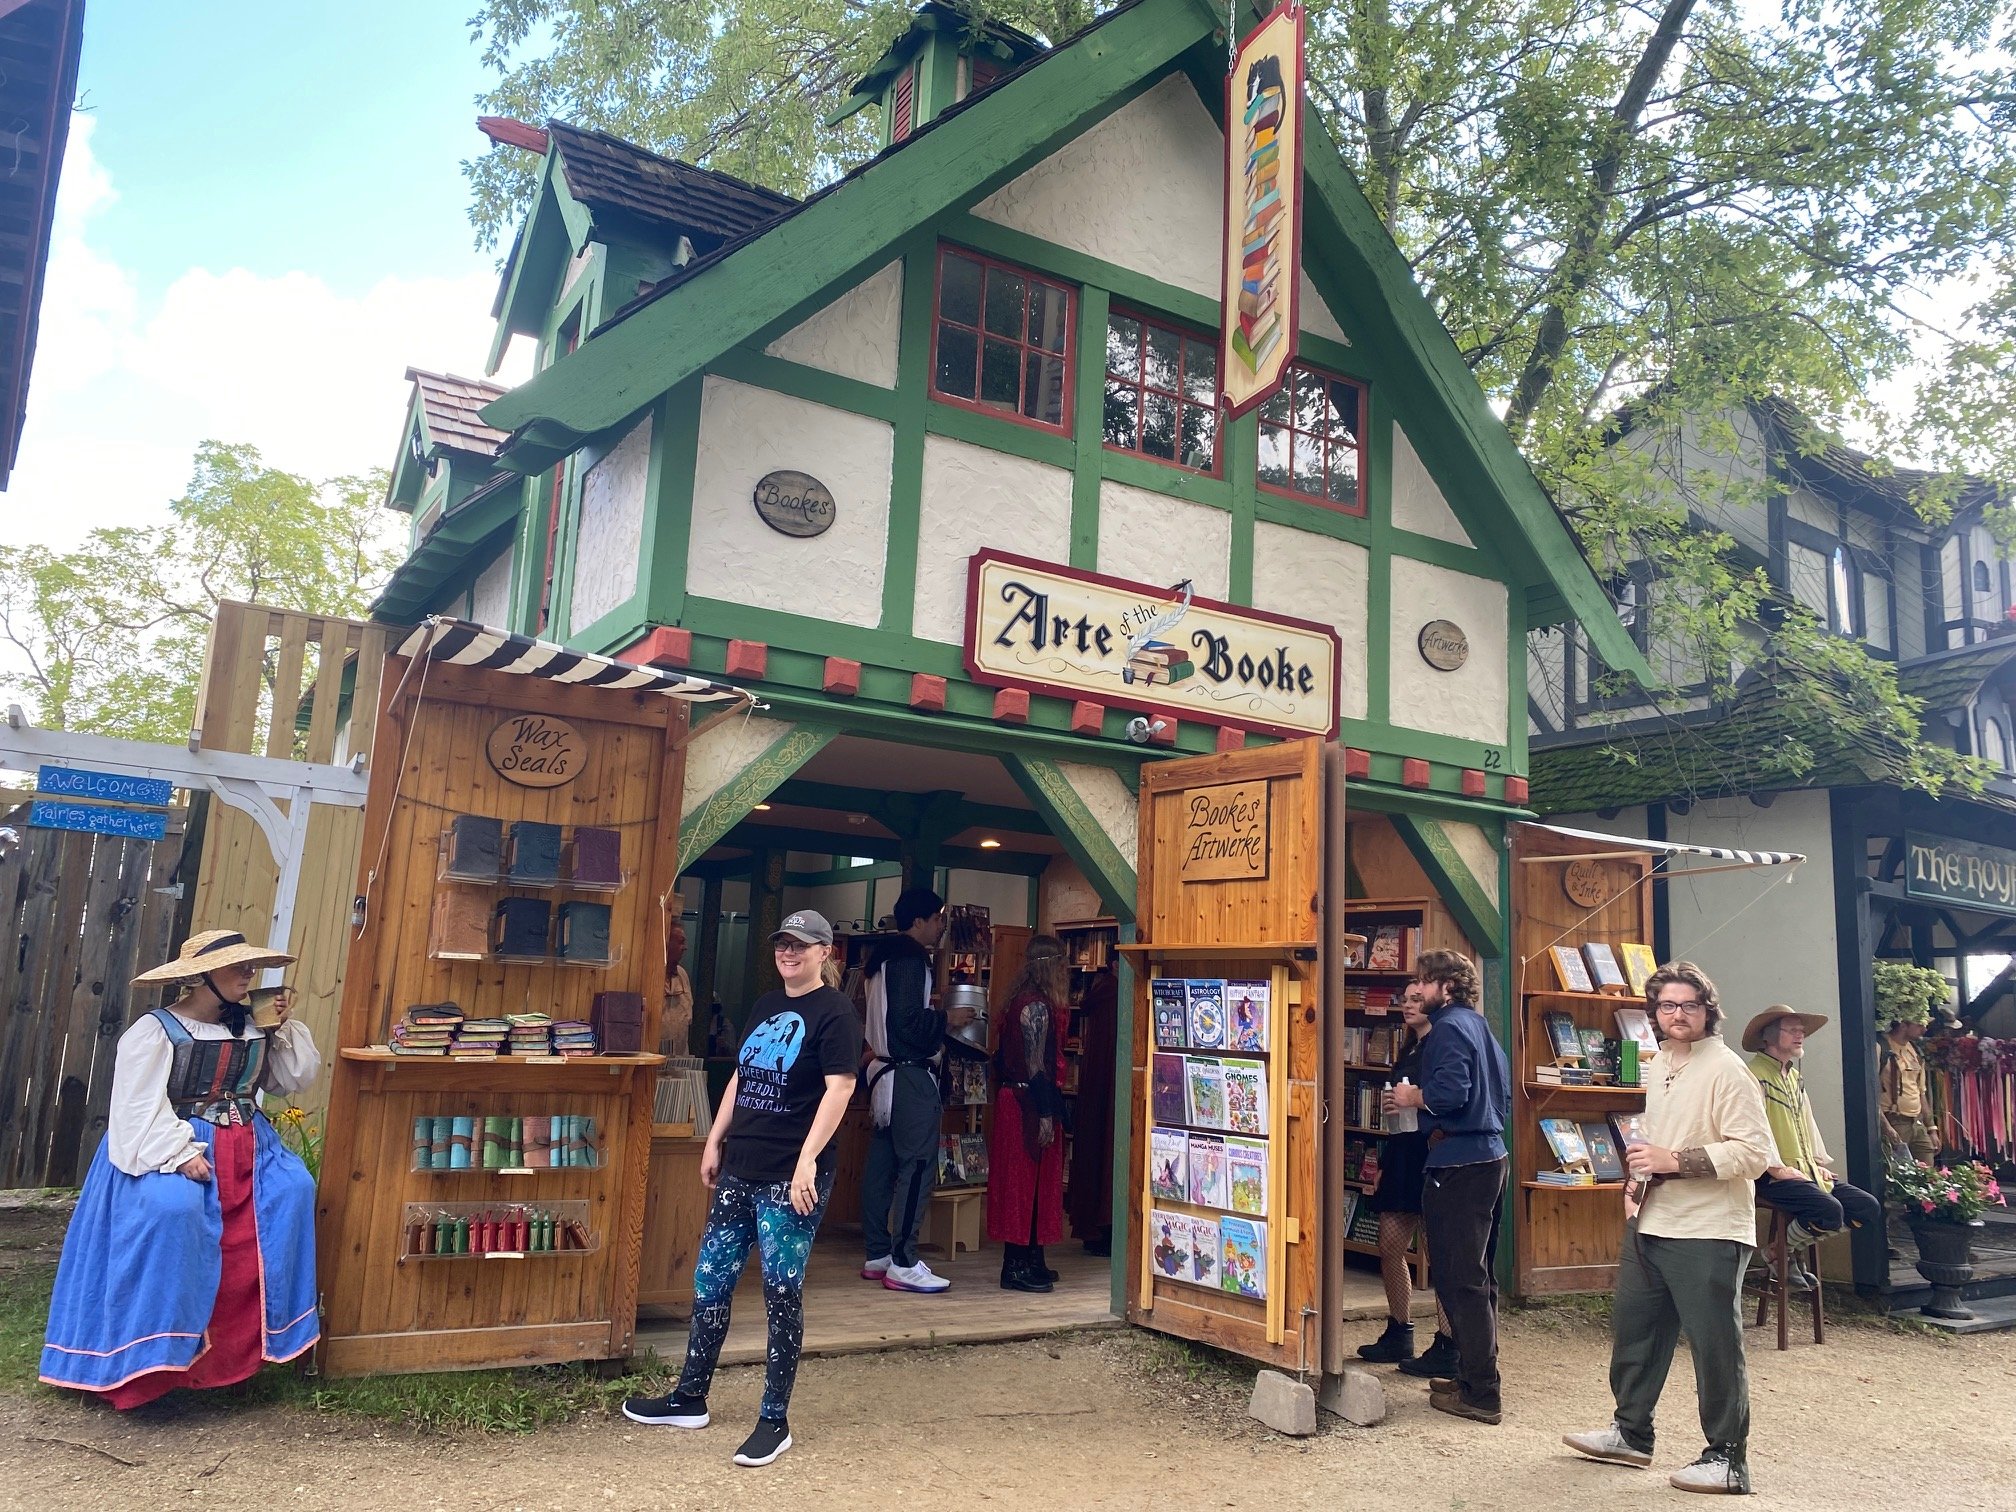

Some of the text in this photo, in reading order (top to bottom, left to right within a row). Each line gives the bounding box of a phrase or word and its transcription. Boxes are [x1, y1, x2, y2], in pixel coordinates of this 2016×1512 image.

[762, 483, 829, 522] Bookes
[994, 581, 1315, 695] Arte of the Booke
[1422, 631, 1469, 660] Artwerke
[512, 718, 569, 750] Wax
[502, 745, 571, 775] Seals
[1484, 749, 1501, 769] 22
[37, 805, 157, 832] Fairies gather here
[1188, 791, 1260, 833] Bookes
[1182, 824, 1260, 870] Artwerke
[1571, 860, 1598, 880] Quill
[1579, 881, 1601, 903] Inke
[739, 1066, 787, 1086] SWEET LIKE
[743, 1080, 781, 1098] DEADLY
[1225, 1072, 1258, 1083] GNOMES
